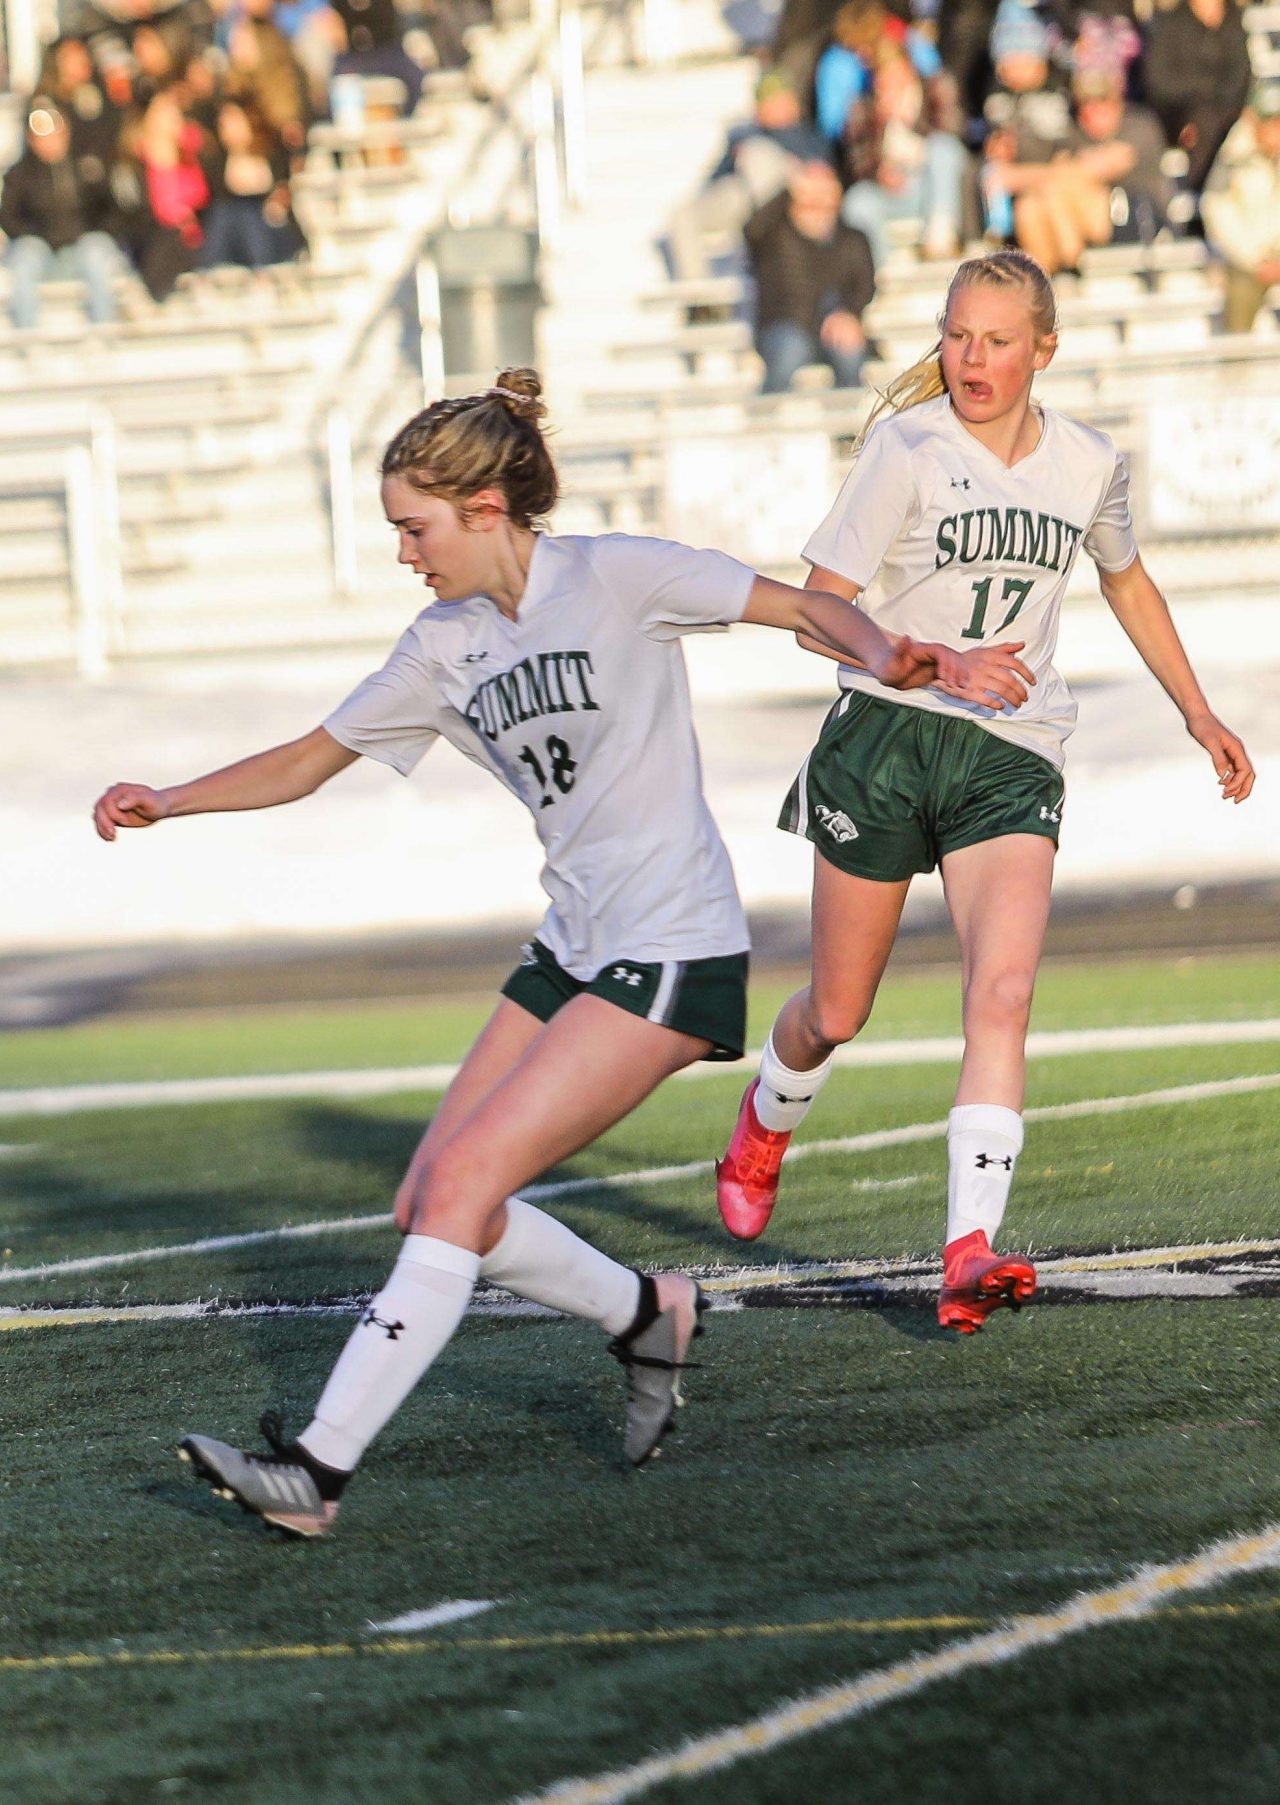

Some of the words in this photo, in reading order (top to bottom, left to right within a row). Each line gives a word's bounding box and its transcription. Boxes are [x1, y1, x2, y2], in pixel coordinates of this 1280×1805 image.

[935, 507, 1084, 575] SUMMIT
[961, 576, 1035, 639] 17
[518, 734, 578, 808] 18
